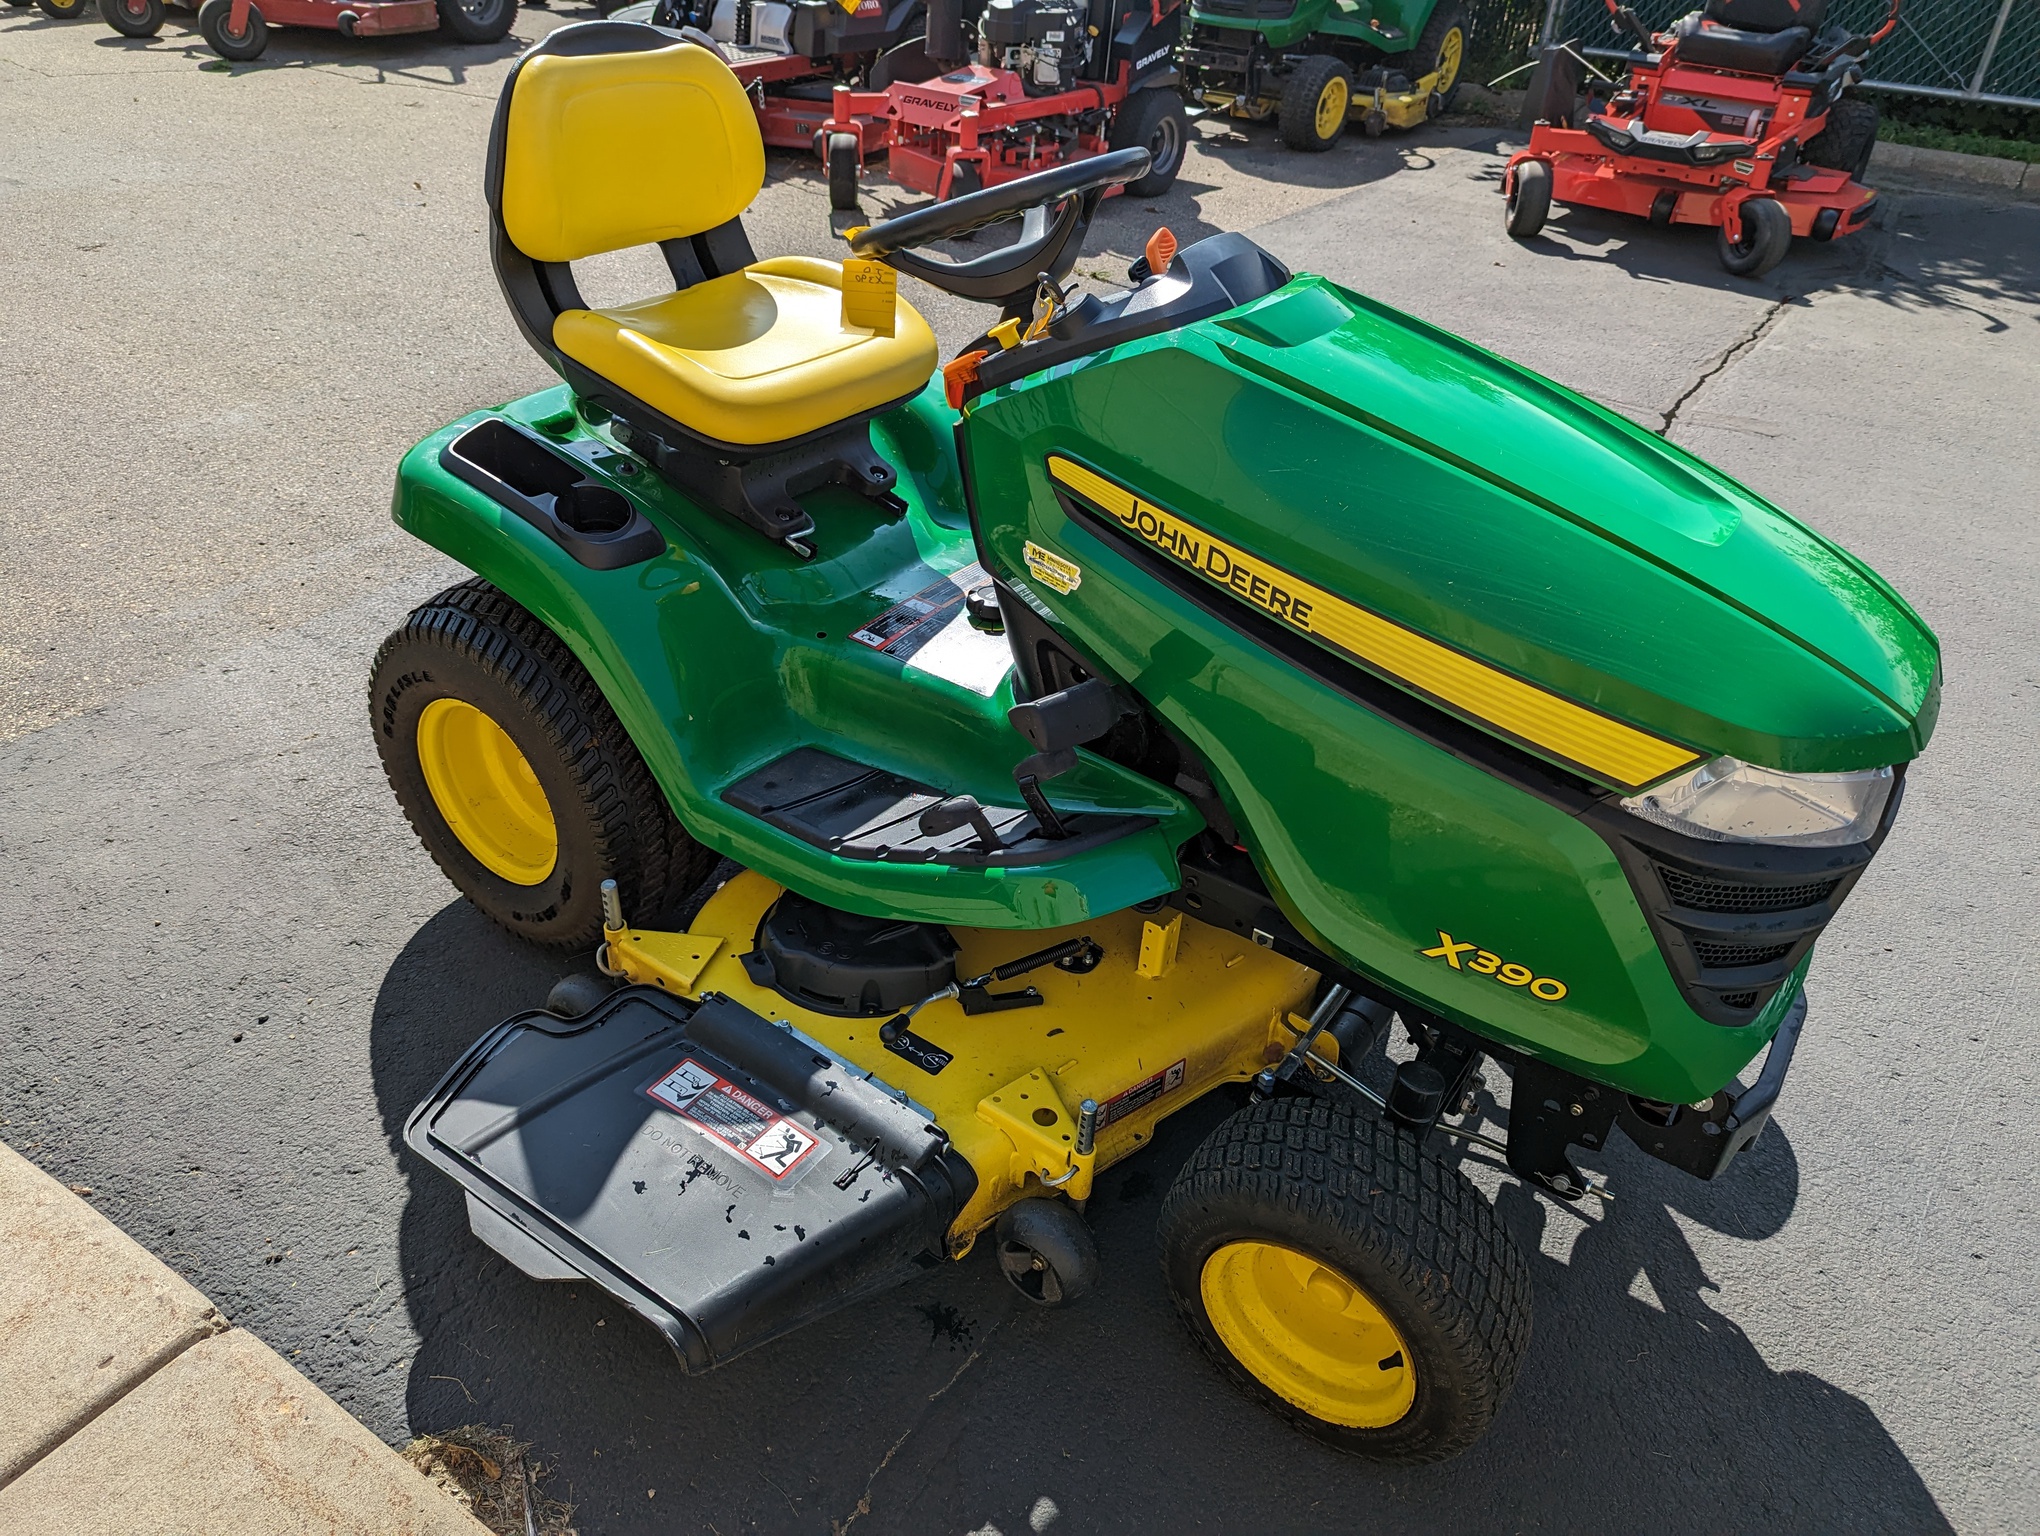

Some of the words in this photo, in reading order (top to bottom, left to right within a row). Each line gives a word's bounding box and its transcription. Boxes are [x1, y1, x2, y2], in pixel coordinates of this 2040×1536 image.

[1136, 45, 1170, 70] GRAVELY
[903, 95, 959, 113] GRAVELY
[1681, 97, 1717, 109] XL
[1721, 115, 1745, 126] 52
[1640, 136, 1685, 148] GRAVELY
[1032, 547, 1047, 561] ME
[1120, 500, 1200, 565] JOHN
[1205, 545, 1313, 627] DEERE
[383, 670, 434, 738] CARLISLE
[1418, 929, 1568, 1001] X390
[1129, 1077, 1153, 1093] DANGER
[731, 1089, 774, 1120] DANGER
[641, 1125, 663, 1140] DO
[662, 1137, 692, 1158] NOT
[687, 1154, 746, 1199] REMOVE
